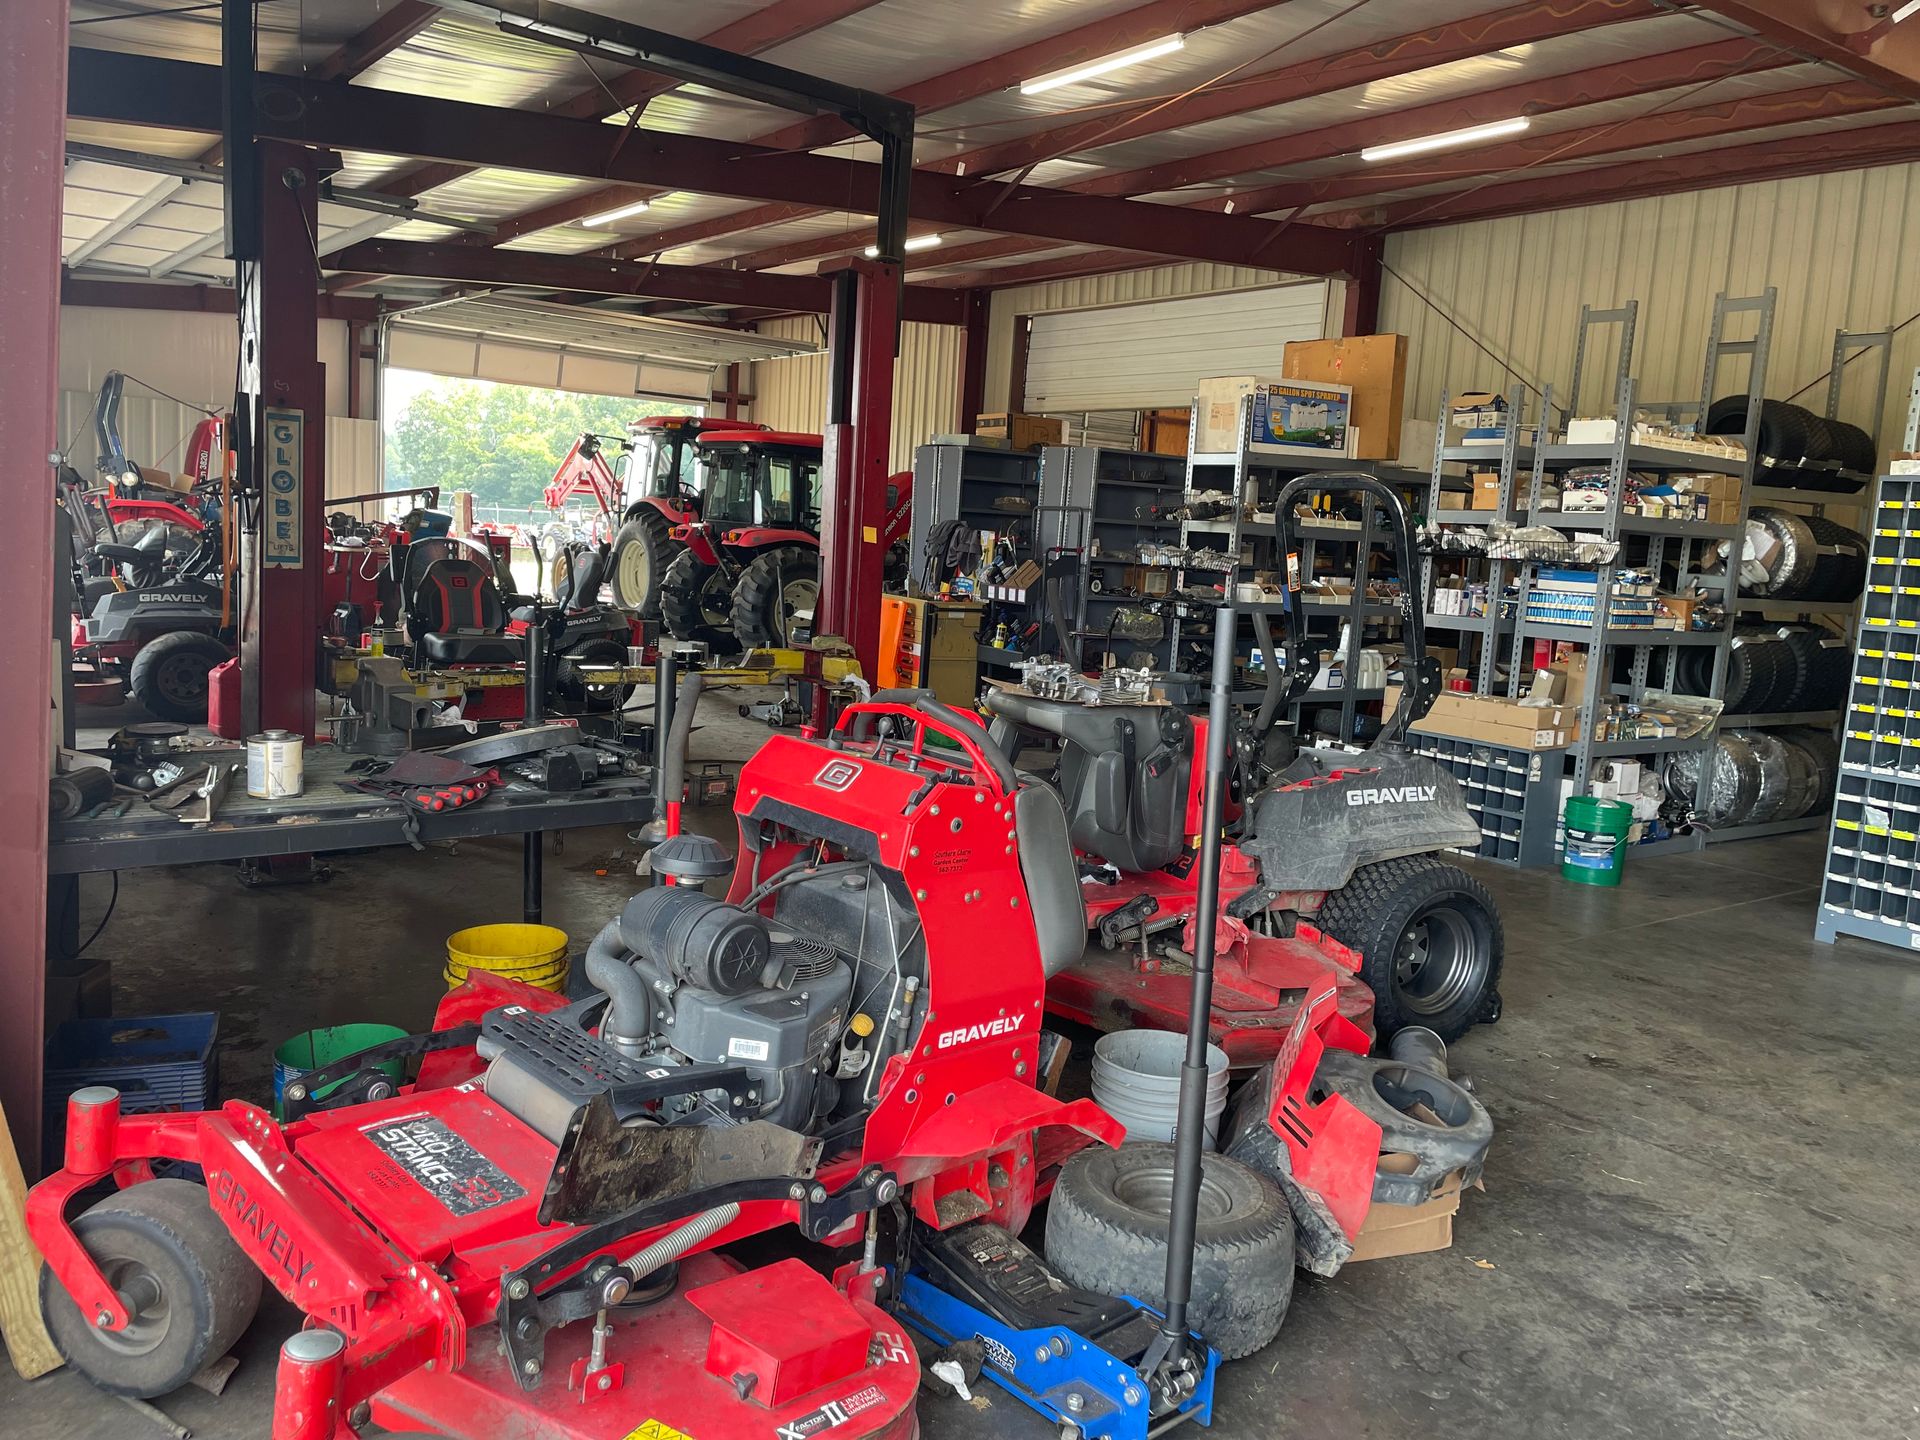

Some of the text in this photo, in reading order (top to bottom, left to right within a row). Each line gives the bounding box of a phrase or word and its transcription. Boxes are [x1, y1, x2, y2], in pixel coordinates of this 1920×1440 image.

[1269, 385, 1278, 394] 25
[1278, 387, 1300, 397] GALLON
[1300, 389, 1315, 399] SPOT
[1316, 391, 1341, 401] SPRAYER
[271, 425, 296, 539] GLOBE
[138, 592, 209, 603] GRAVELY
[566, 615, 602, 627] GRAVELY
[1346, 785, 1437, 806] GRAVELY
[938, 1013, 1025, 1049] GRAVELY
[377, 1128, 458, 1185] STANCE
[216, 1167, 315, 1283] GRAVELY
[876, 1331, 910, 1364] 52
[839, 1386, 877, 1407] LIMITED
[842, 1392, 880, 1411] LIFETIME
[776, 1421, 806, 1440] X
[794, 1413, 825, 1432] FACTOR
